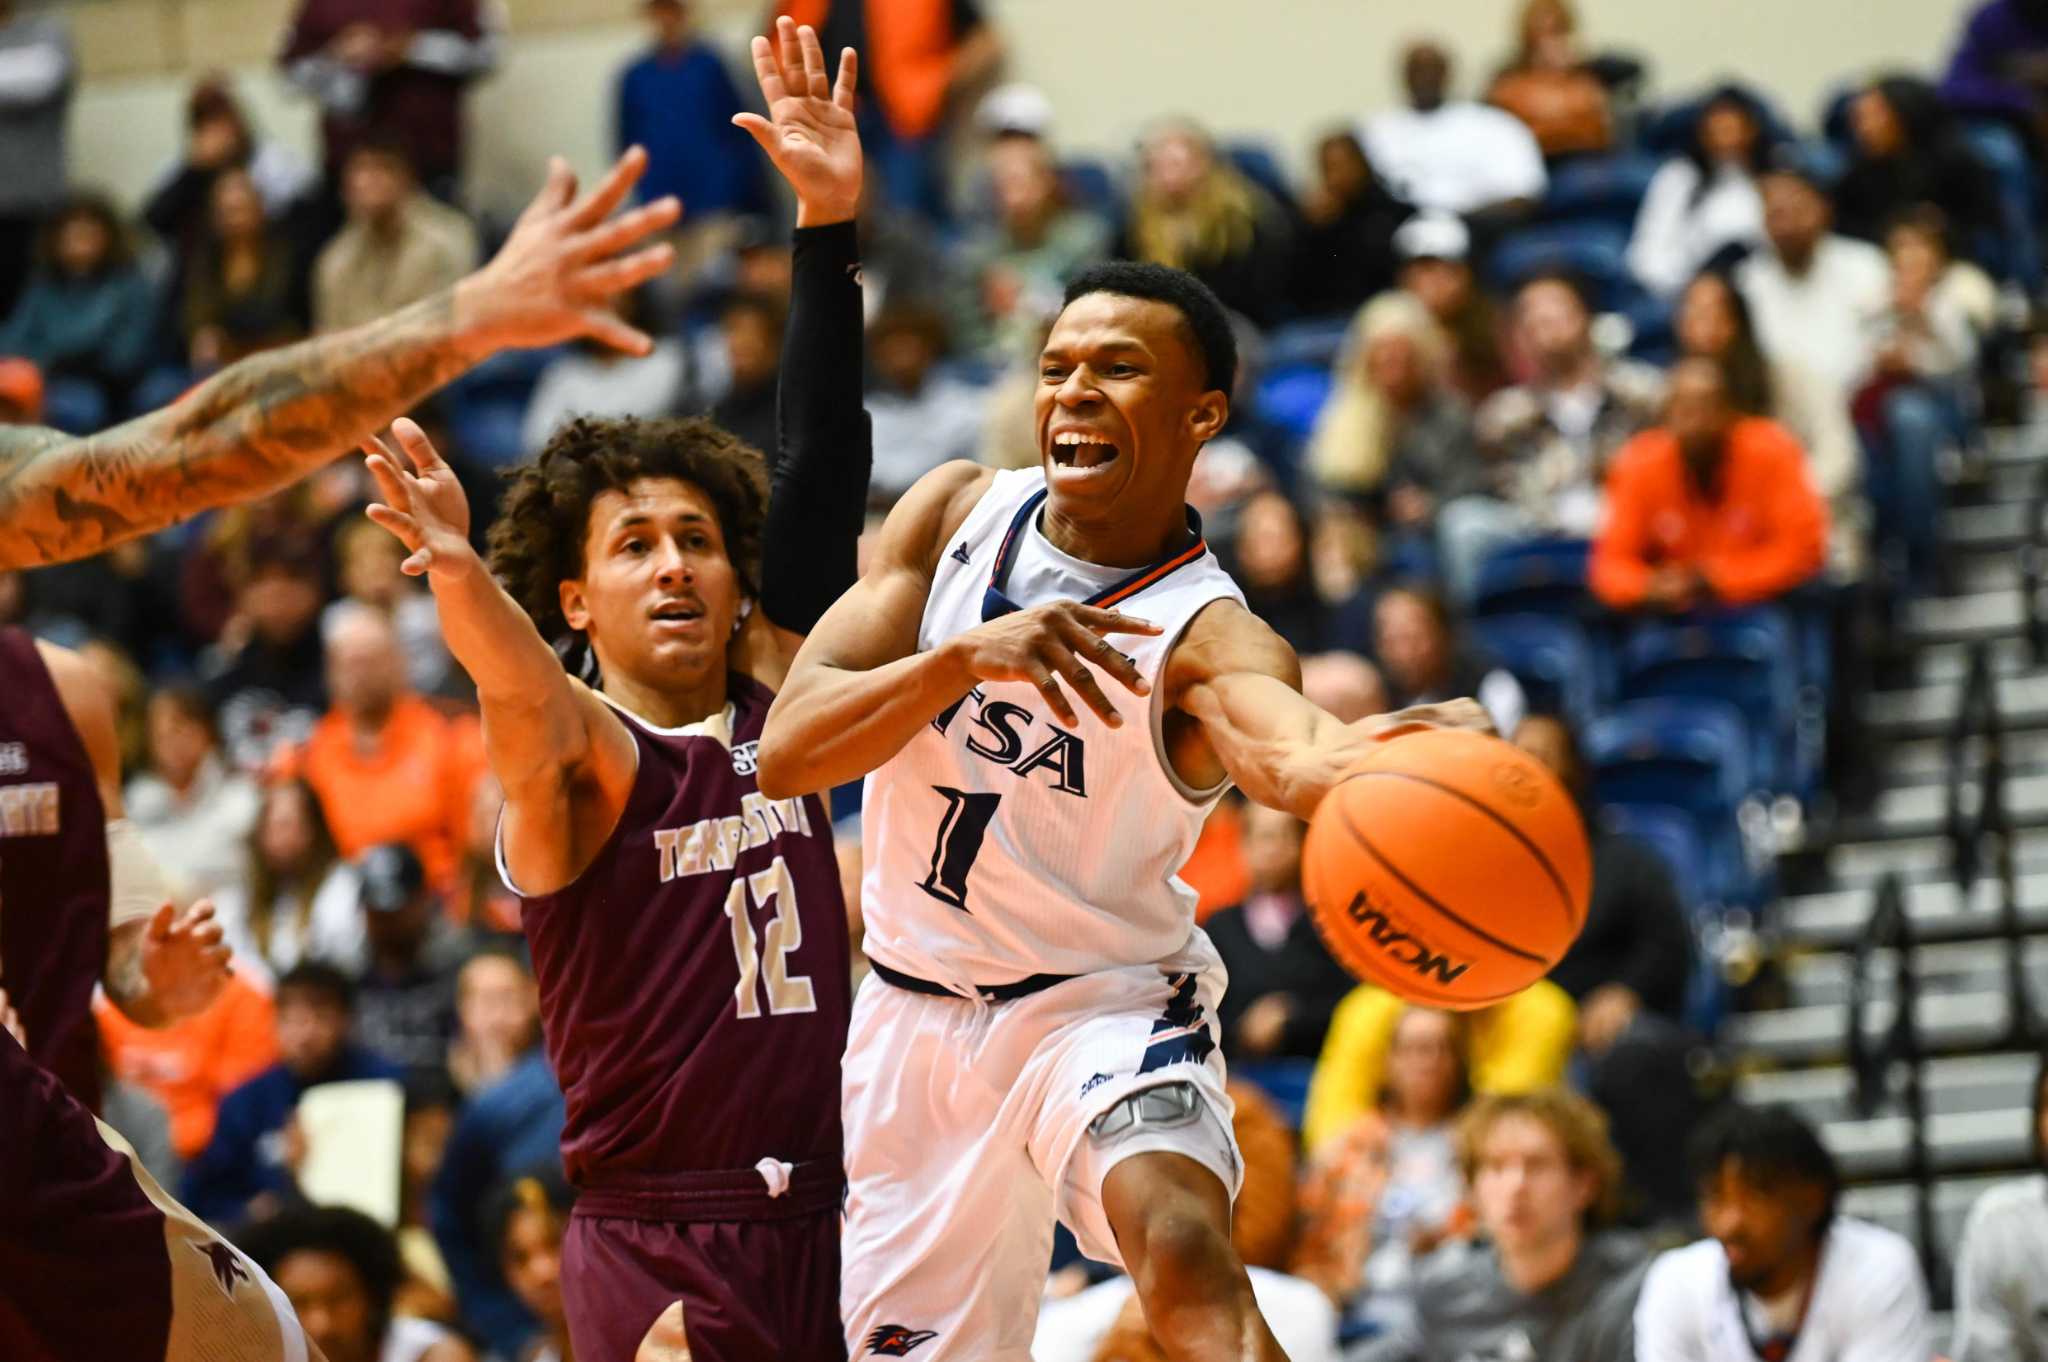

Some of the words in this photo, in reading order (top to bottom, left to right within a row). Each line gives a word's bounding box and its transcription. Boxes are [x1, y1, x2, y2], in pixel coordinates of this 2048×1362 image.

[931, 688, 1088, 798] TSA
[914, 785, 1002, 915] 1
[724, 856, 817, 1018] 12
[1348, 890, 1468, 983] NCAA
